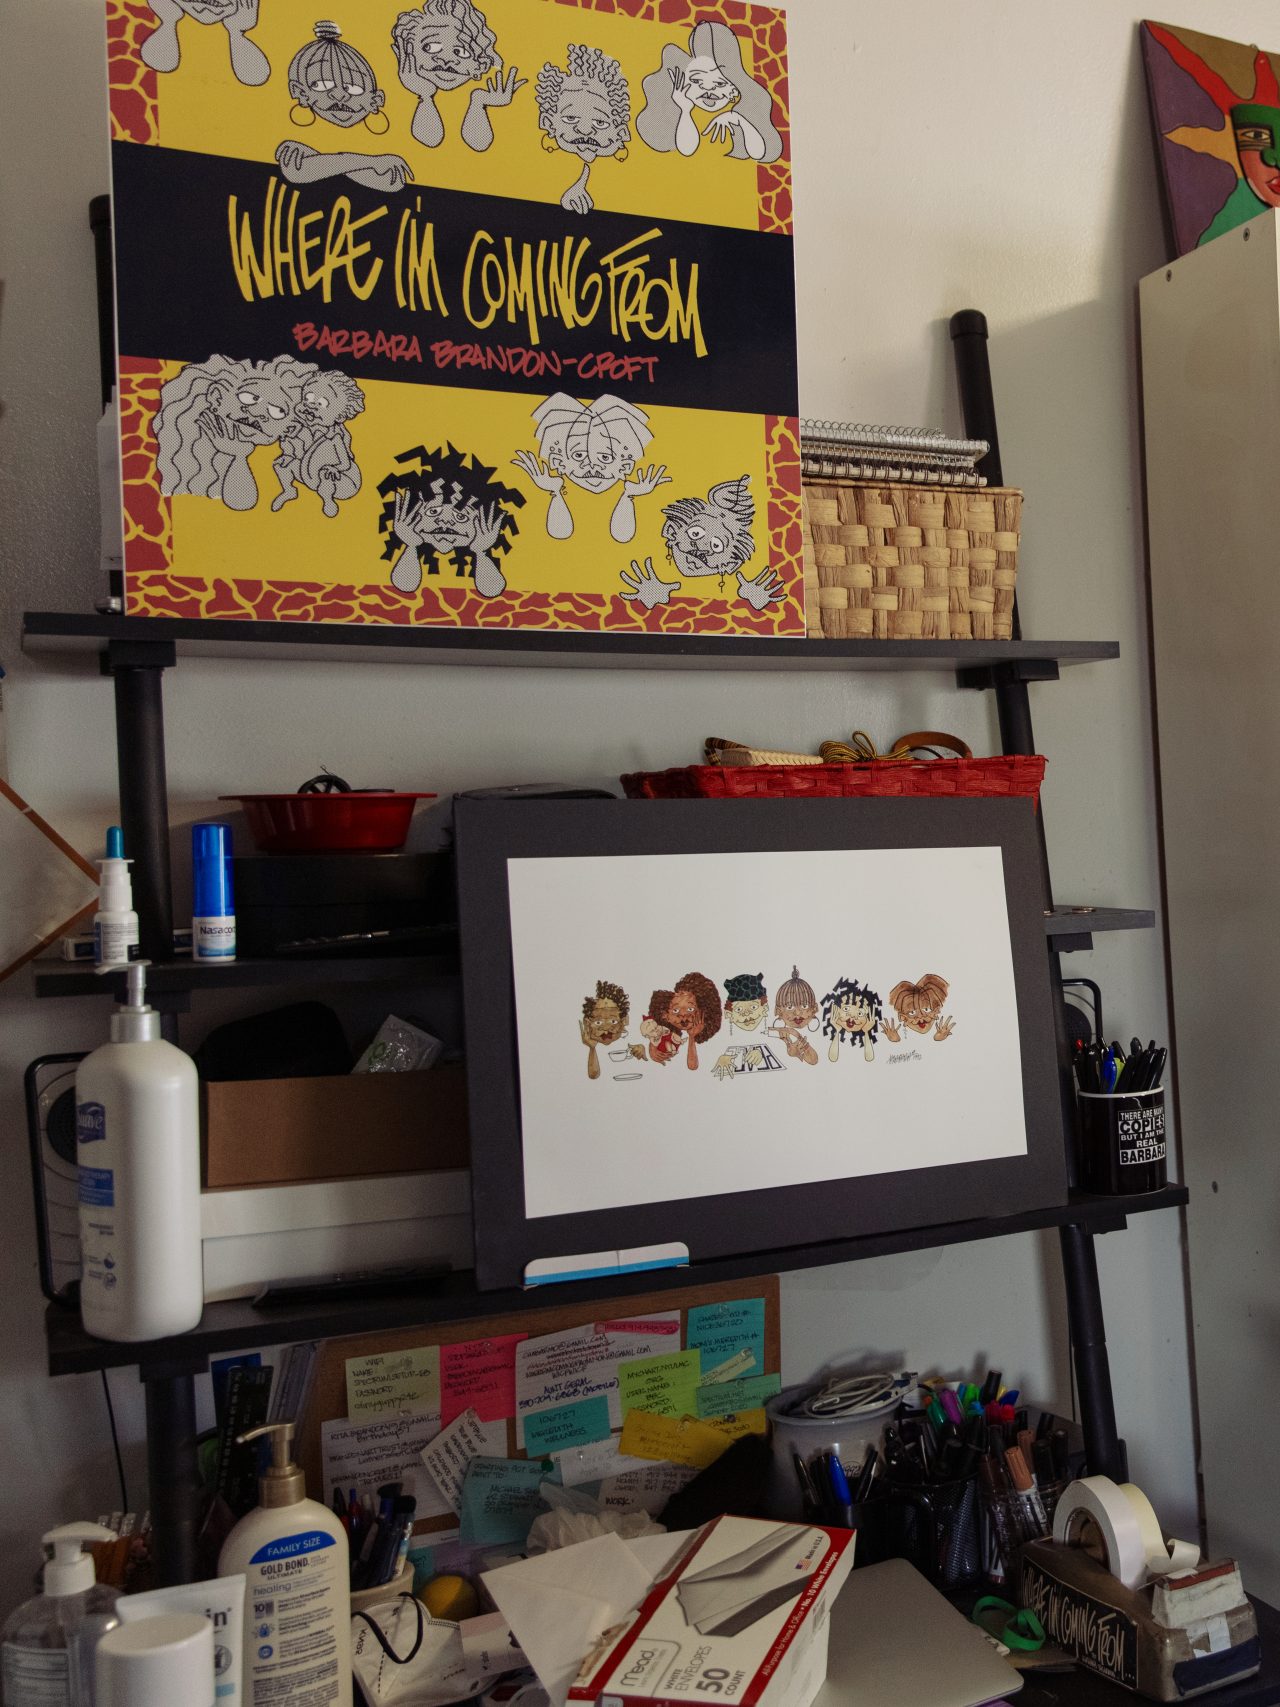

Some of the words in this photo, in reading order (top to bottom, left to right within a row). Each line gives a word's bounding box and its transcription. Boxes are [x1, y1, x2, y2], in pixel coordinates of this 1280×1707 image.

[228, 176, 389, 302] WHERE
[395, 196, 450, 316] I'M
[461, 229, 603, 344] COMING
[599, 227, 709, 357] FROM
[292, 321, 423, 364] BARBARA
[431, 340, 659, 383] BRANDON-CROFT
[1120, 1109, 1142, 1121] THERE
[1142, 1108, 1153, 1119] ARE
[1120, 1114, 1165, 1134] COPIES
[1120, 1132, 1138, 1141] BUT
[1145, 1130, 1155, 1138] AM
[1156, 1128, 1165, 1136] THE
[1136, 1138, 1158, 1148] REAL
[1121, 1143, 1165, 1164] BARBARA
[267, 1542, 301, 1557] FAMILY
[303, 1536, 321, 1549] SIZE
[261, 1563, 283, 1576] GOLD
[267, 1569, 303, 1581] ULTIMATE
[801, 1596, 813, 1608] No.
[811, 1572, 826, 1590] White
[820, 1551, 839, 1576] Envelopes
[253, 1581, 292, 1596] healing
[254, 1603, 264, 1613] 10
[1060, 1596, 1098, 1659] COMING
[664, 1668, 683, 1690] WHITE
[675, 1645, 713, 1692] ENVELOPES
[696, 1667, 731, 1693] 50
[724, 1670, 746, 1696] COUNT
